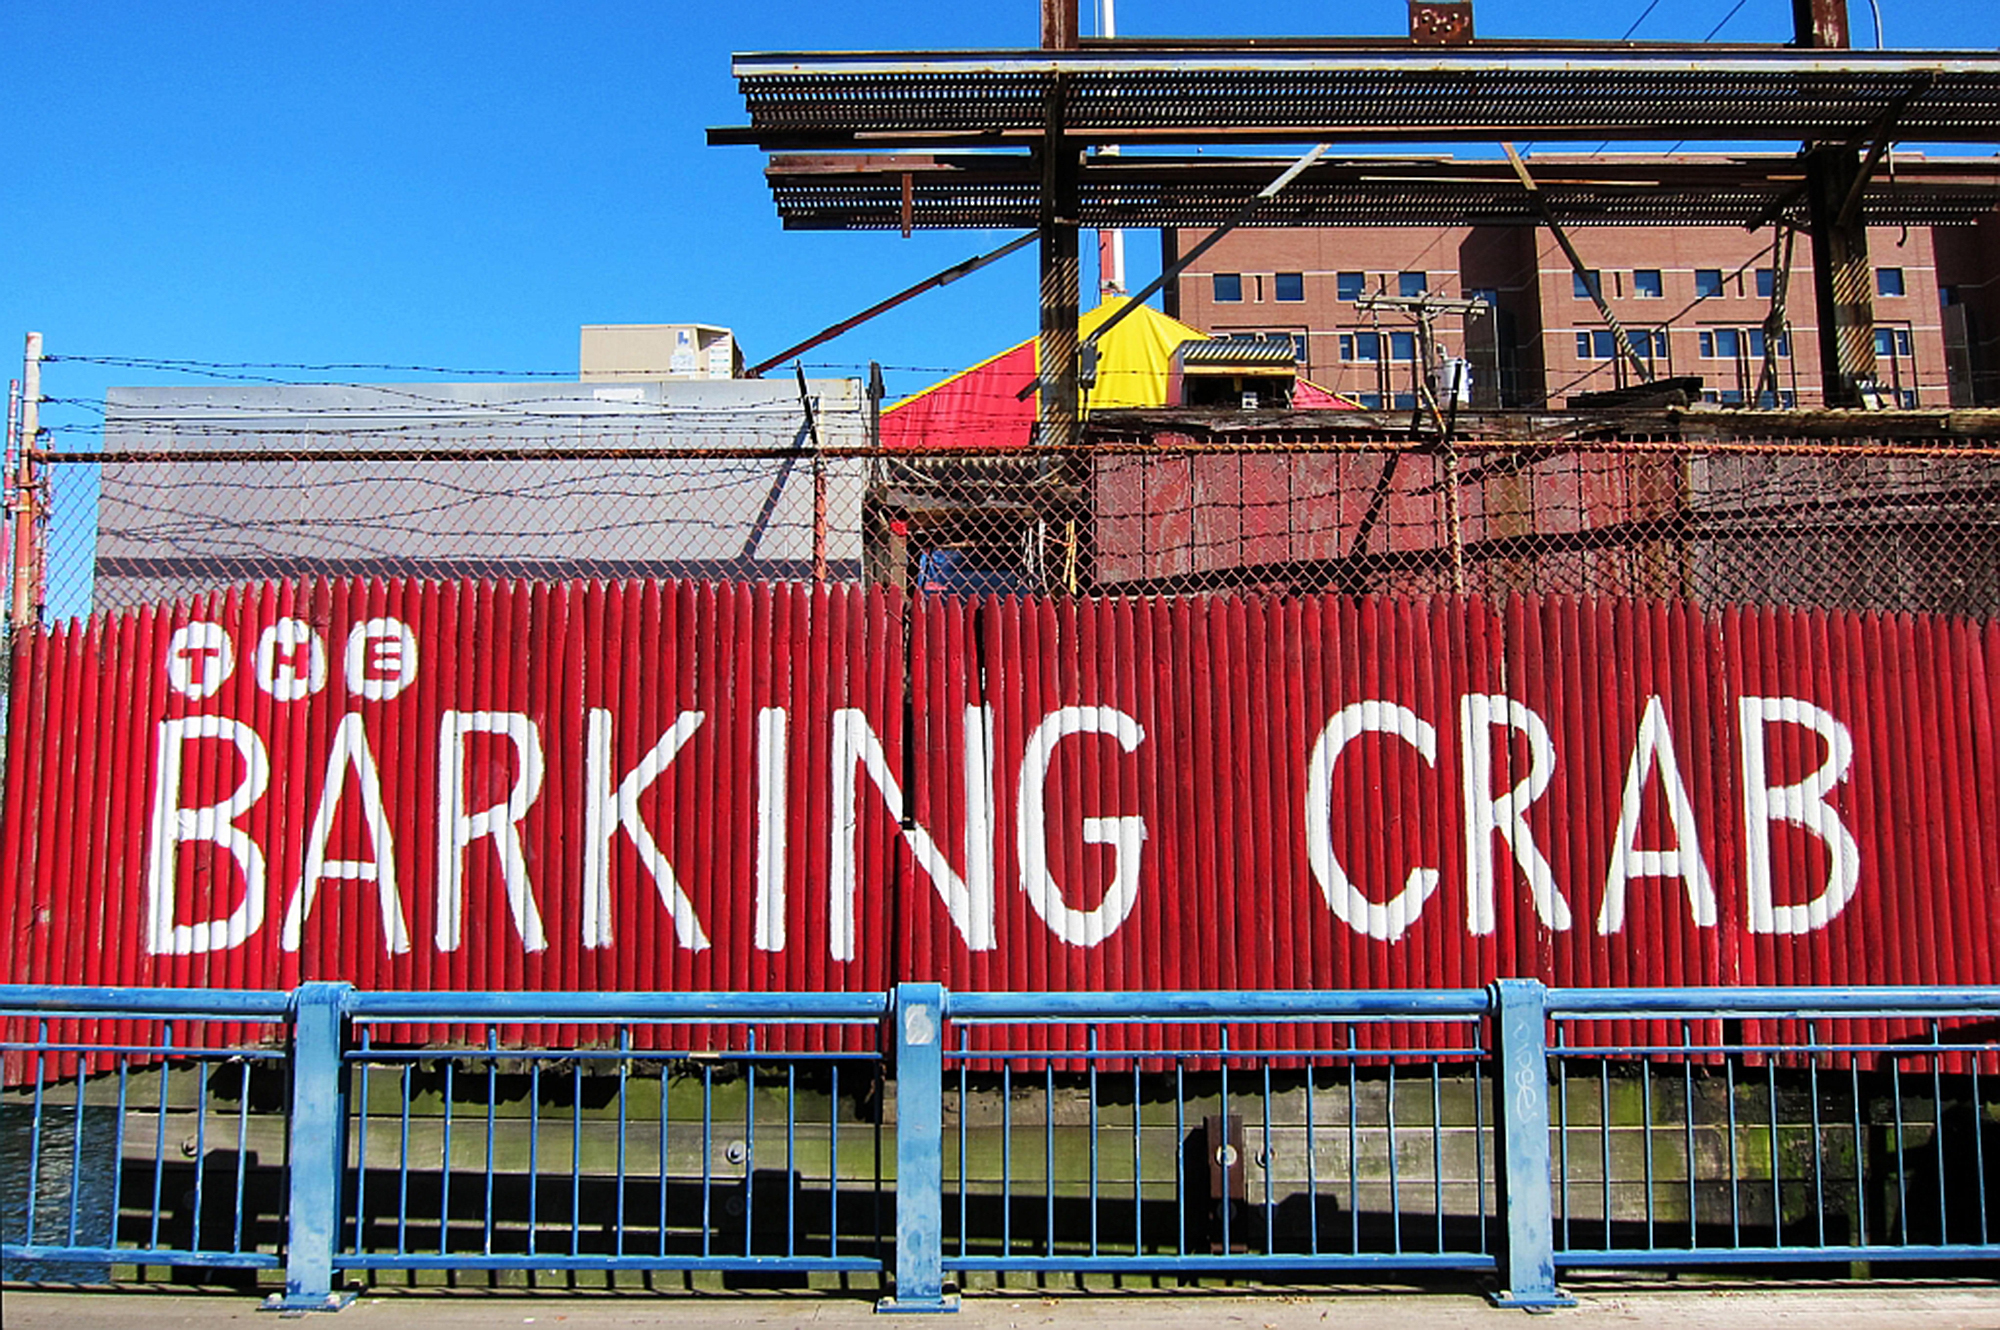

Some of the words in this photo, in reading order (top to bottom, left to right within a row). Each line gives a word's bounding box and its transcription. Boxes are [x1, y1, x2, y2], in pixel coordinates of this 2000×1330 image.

[166, 617, 418, 702] THE
[146, 704, 1148, 962] BARKING
[1306, 693, 1861, 945] CRAB
